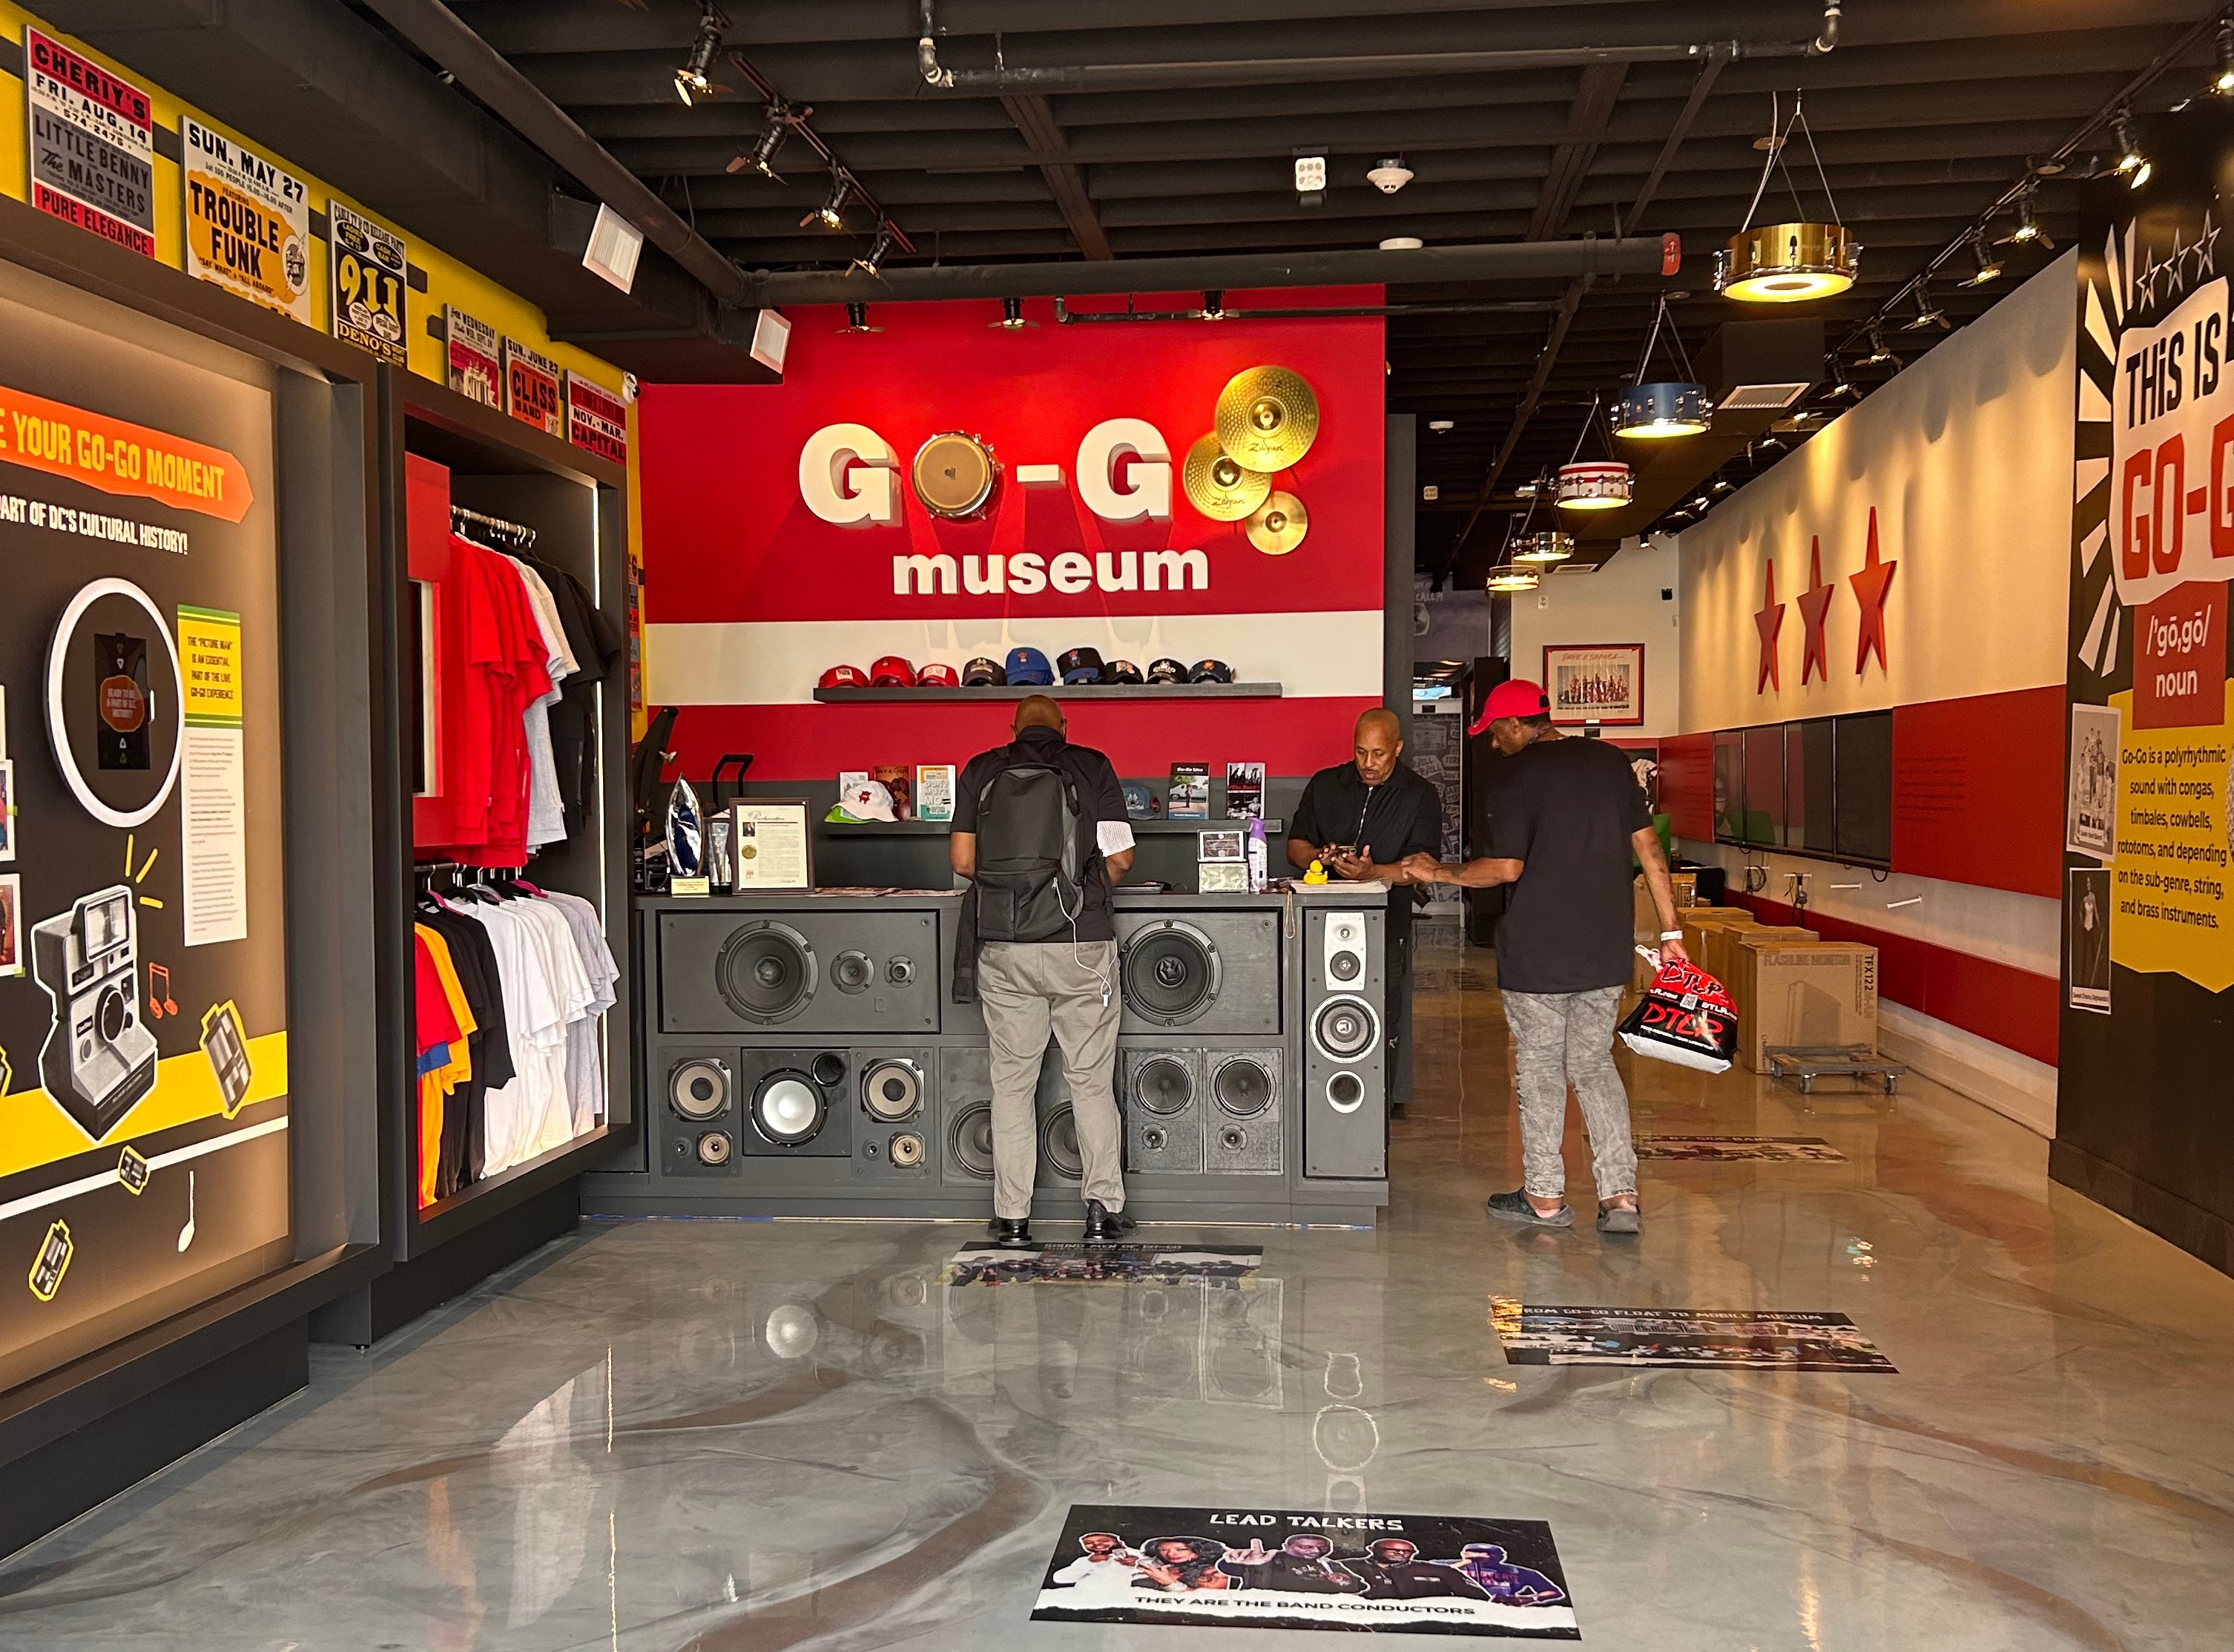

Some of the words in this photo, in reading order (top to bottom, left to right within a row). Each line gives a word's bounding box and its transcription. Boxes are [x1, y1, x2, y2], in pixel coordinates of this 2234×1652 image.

[35, 43, 145, 119] CHERIY'S
[36, 73, 73, 105] FRI.
[82, 99, 123, 131] AUG.
[130, 124, 146, 143] 14
[35, 114, 95, 162] LITTLE
[99, 147, 148, 188] BENNY
[189, 122, 234, 166] SUN.
[241, 151, 276, 188] MAY
[283, 176, 303, 203] 27
[41, 148, 63, 172] The
[68, 159, 145, 214] MASTERS
[223, 187, 249, 206] FEATURING
[225, 172, 246, 188] PEOPLE
[41, 188, 78, 223] PURE
[84, 210, 148, 254] ELEGANCE
[190, 180, 280, 254] TROUBLE
[211, 226, 262, 280] FUNK
[340, 254, 401, 326] 911
[339, 322, 392, 355] DENO'S
[508, 339, 526, 358] SUN.
[528, 351, 547, 369] JUNE
[550, 360, 558, 374] 23
[2193, 312, 2221, 401] IS
[513, 369, 556, 413] CLASS
[515, 398, 541, 420] BAND
[571, 423, 626, 460] CAPITAL
[574, 407, 595, 427] NOV.
[602, 421, 623, 441] MAR.
[12, 411, 71, 465] YOUR
[77, 430, 140, 480] GO-GO
[146, 448, 224, 501] MOMENT
[0, 494, 27, 523] ART
[30, 501, 47, 527] OF
[48, 504, 77, 533] DC'S
[79, 511, 138, 544] CULTURAL
[139, 523, 188, 555] HISTORY!
[893, 549, 1209, 595] museum
[2155, 669, 2198, 698] noun
[2122, 748, 2147, 764] Go-Go
[2149, 746, 2155, 764] is
[2158, 751, 2162, 763] a
[2164, 743, 2226, 769] polyrhythmic
[2130, 777, 2155, 794] sound
[2157, 777, 2176, 795] with
[2179, 782, 2214, 800] congas,
[2131, 807, 2168, 829] timbales,
[2170, 810, 2212, 831] cowbells,
[2118, 839, 2155, 859] rototoms,
[2158, 841, 2175, 858] and
[2176, 841, 2227, 867] depending
[2118, 870, 2128, 883] on
[2130, 869, 2144, 886] the
[2145, 871, 2192, 895] sub-genre,
[2194, 876, 2224, 901] string,
[2121, 898, 2135, 914] and
[2138, 899, 2159, 918] brass
[2161, 902, 2218, 929] instruments.
[1660, 959, 1729, 1004] DTLR
[1641, 1003, 1723, 1044] DTLR
[1210, 1513, 1276, 1526] LEAD
[1287, 1516, 1404, 1531] TALKERS
[1135, 1596, 1185, 1605] THEY
[1277, 1602, 1334, 1610] BAND
[1337, 1604, 1476, 1614] CONDUCTORS
